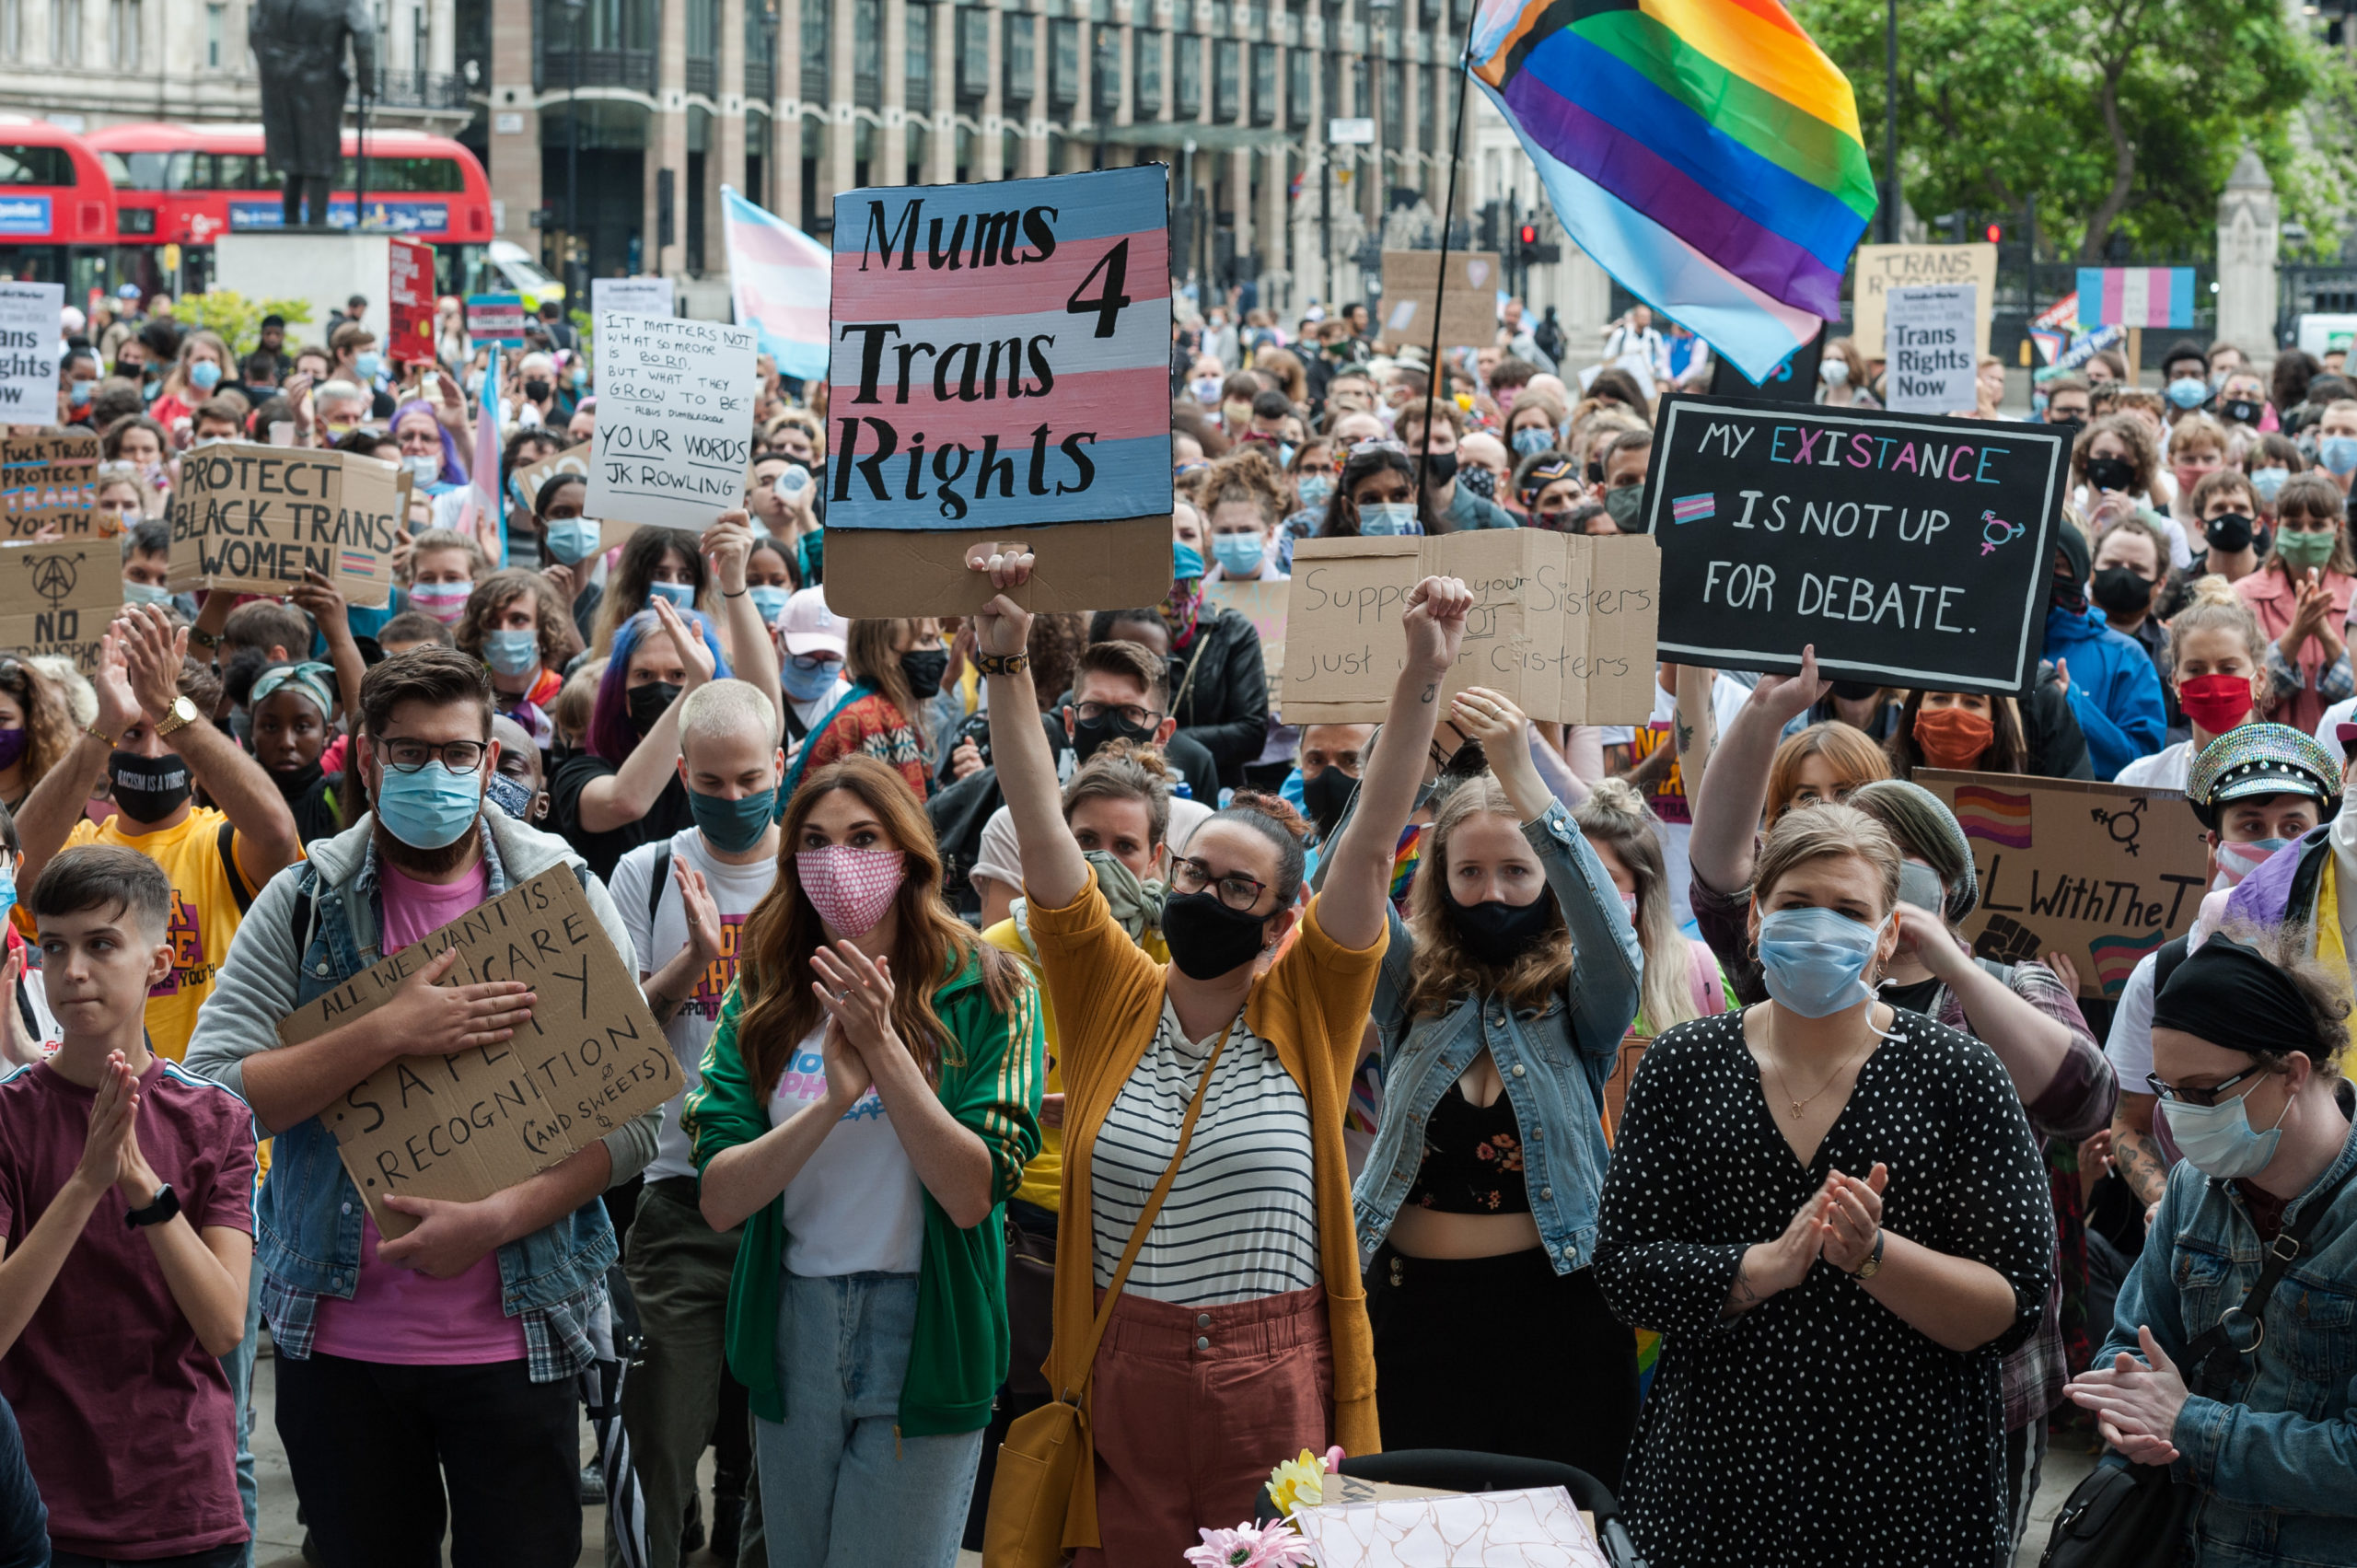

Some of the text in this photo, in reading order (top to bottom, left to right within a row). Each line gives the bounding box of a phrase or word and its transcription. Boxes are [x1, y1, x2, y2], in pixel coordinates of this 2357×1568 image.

[858, 197, 1131, 339] Mums 4
[1875, 250, 1972, 275] TRANS
[608, 332, 652, 347] WHAT
[644, 320, 717, 343] MATTERS
[724, 331, 753, 347] NOT
[1894, 325, 1956, 347] Trans
[608, 366, 730, 391] BUT WHAT THEY
[840, 323, 1056, 405] Trans
[1897, 349, 1970, 375] Rights
[0, 387, 23, 404] w
[610, 382, 666, 402] GROW
[679, 392, 707, 405] TO
[1897, 376, 1946, 398] Now
[599, 424, 748, 465] YOUR WORDS
[1698, 422, 2011, 484] MY EXISTANCE
[2, 465, 93, 488] PROTECT
[180, 456, 343, 498] PROTECT
[605, 462, 737, 496] JK ROWLING
[829, 416, 1097, 521] Rights
[1, 482, 97, 513] TRANS
[173, 497, 393, 554] BLACK TRANS
[1732, 490, 1951, 545] IS NOT UP
[198, 538, 331, 583] WOMEN
[1306, 565, 1651, 624] Suppo your Sisters
[1703, 560, 1977, 634] FOR DEBATE.
[35, 610, 79, 644] NO
[1295, 645, 1373, 682] just
[117, 769, 186, 792] RACISM IS A VIRUS
[321, 983, 368, 1022] ALL
[372, 952, 412, 989] WE
[422, 896, 509, 960] WANT
[678, 1001, 722, 1016] PPORT
[577, 1047, 671, 1120] SWEETS)
[376, 1014, 640, 1189] RECOGNITION
